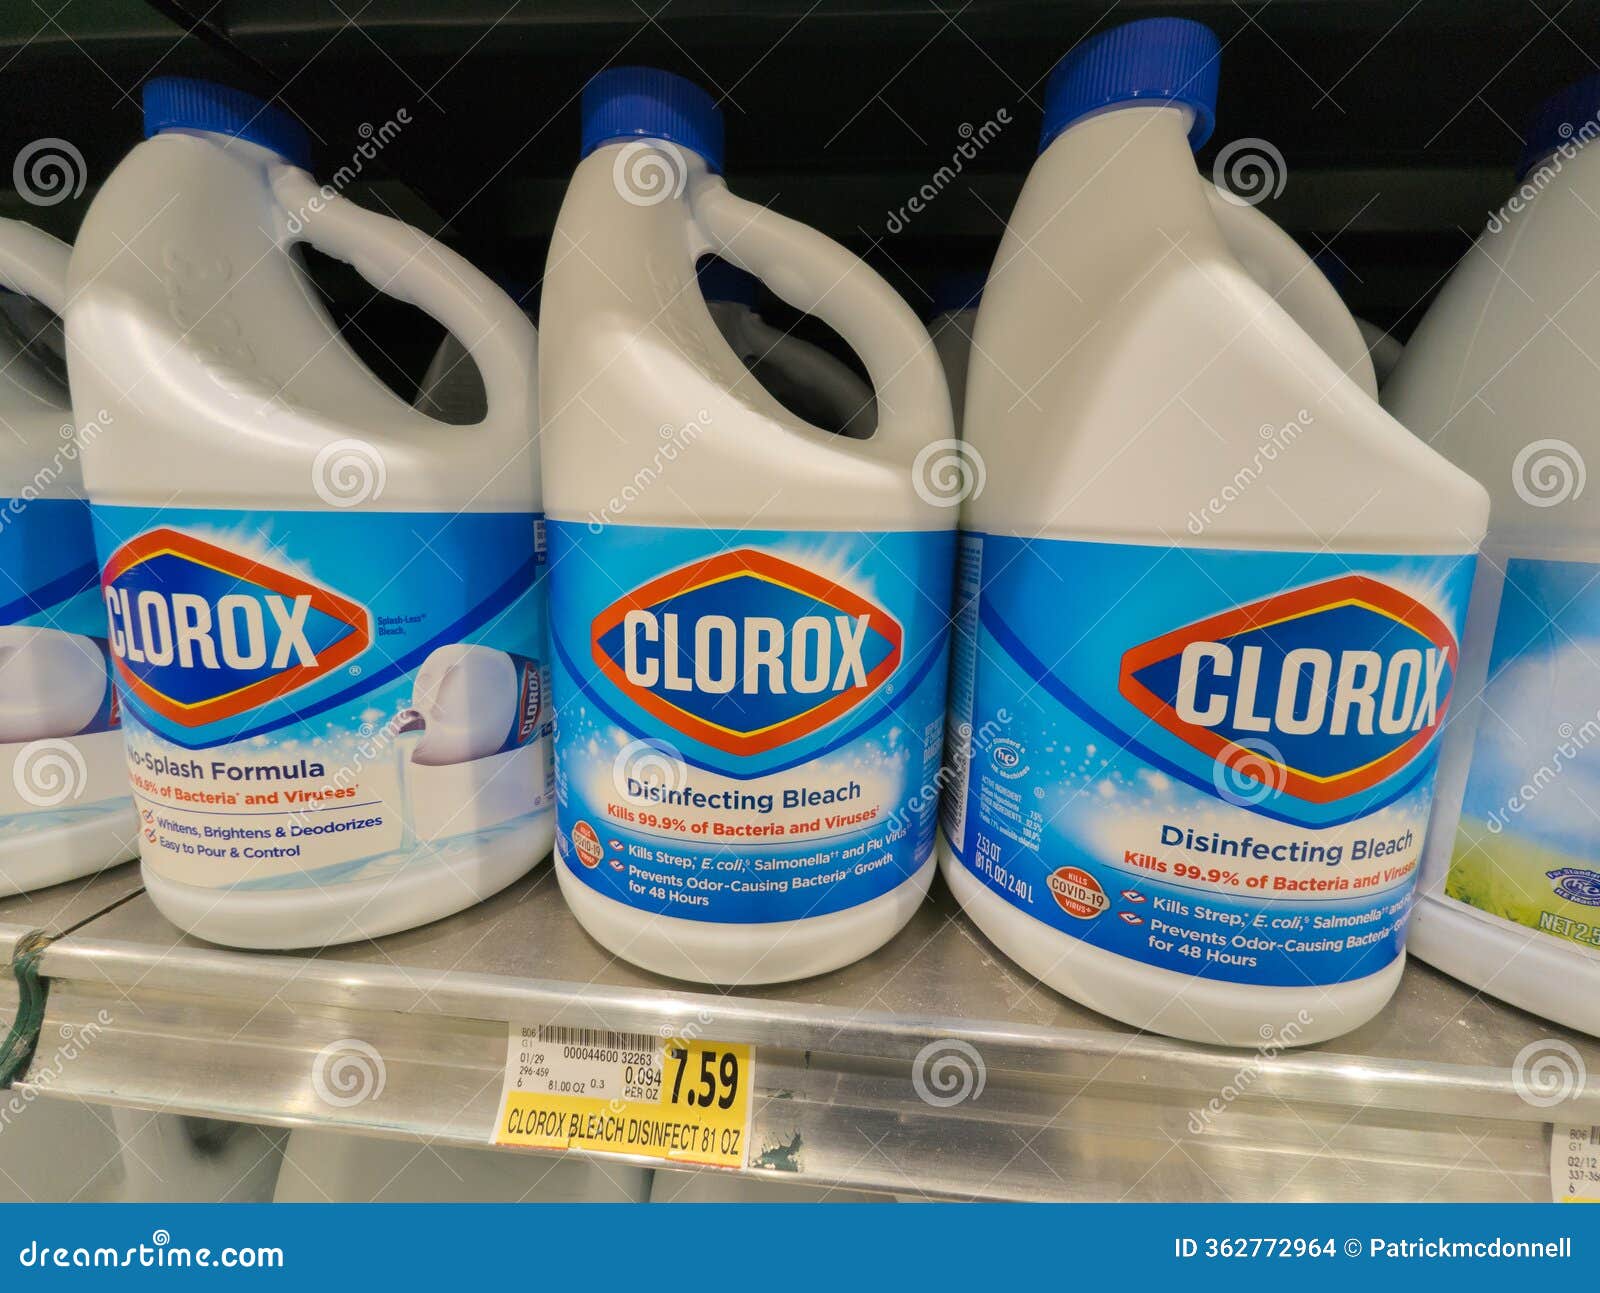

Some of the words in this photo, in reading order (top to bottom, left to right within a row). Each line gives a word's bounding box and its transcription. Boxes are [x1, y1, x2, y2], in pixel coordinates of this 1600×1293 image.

[104, 585, 319, 670] CLOROX
[623, 609, 872, 695] CLOROX
[521, 669, 539, 737] CLOROX
[1175, 641, 1450, 737] CLOROX
[211, 760, 325, 781] Formula
[160, 786, 172, 798] of
[174, 787, 238, 805] Bacteria
[245, 791, 279, 805] and
[284, 785, 357, 804] Viruses
[627, 777, 773, 813] Disinfecting
[783, 781, 861, 808] Bleach
[157, 815, 201, 837] Whitens,
[204, 826, 271, 841] Brightens
[275, 826, 287, 838] &
[290, 815, 383, 838] Deodorizes
[607, 803, 635, 822] Kills
[638, 812, 687, 832] 99.9%
[691, 822, 709, 834] of
[713, 822, 785, 837] Bacteria
[789, 819, 821, 834] and
[160, 836, 181, 854] Easy
[183, 841, 195, 855] to
[197, 844, 226, 857] Pour
[230, 847, 240, 858] &
[243, 844, 301, 858] Control
[628, 844, 653, 861] Kills
[701, 858, 714, 869] E.
[842, 844, 865, 859] and
[867, 839, 883, 853] Flu
[1160, 825, 1343, 867] Disinfecting
[1351, 829, 1413, 860] Bleach
[628, 865, 683, 887] Prevents
[686, 878, 788, 892] Odor-Causing
[855, 853, 893, 875] Growth
[985, 858, 994, 879] FL
[1008, 874, 1027, 900] 2.40
[1028, 885, 1034, 904] L
[1068, 871, 1088, 886] KILLS
[1124, 850, 1167, 873] Kills
[1173, 862, 1239, 886] 99.9%
[1246, 875, 1268, 889] of
[1273, 876, 1349, 892] Bacteria
[1353, 872, 1381, 889] and
[628, 880, 646, 894] for
[649, 888, 666, 900] 48
[669, 891, 709, 906] Hours
[1051, 877, 1104, 908] COVID-19
[1153, 897, 1189, 916] Kills
[1252, 914, 1268, 928] E.
[1150, 918, 1227, 946] Prevents
[1231, 935, 1343, 953] Odor-Causing
[1539, 911, 1575, 936] NET
[1574, 923, 1600, 946] 2.5
[1148, 935, 1174, 952] for
[1178, 942, 1201, 959] 48
[1206, 949, 1257, 967] Hours
[520, 1052, 545, 1065] 01/29
[564, 1047, 618, 1063] 000044600
[621, 1052, 652, 1066] 32263
[517, 1078, 522, 1087] 6
[548, 1079, 571, 1092] 81.00
[573, 1083, 585, 1094] OZ
[590, 1078, 605, 1089] 0.3
[624, 1066, 662, 1086] 0.094
[670, 1048, 739, 1110] 7.59
[625, 1087, 643, 1098] PER
[645, 1088, 659, 1100] OZ
[507, 1107, 567, 1138] CLOROX
[568, 1113, 625, 1143] BLEACH
[627, 1118, 700, 1151] DISINFECT
[701, 1127, 716, 1153] 81
[720, 1128, 741, 1155] OZ
[1568, 1156, 1597, 1169] 02/12
[1569, 1182, 1575, 1194] 6
